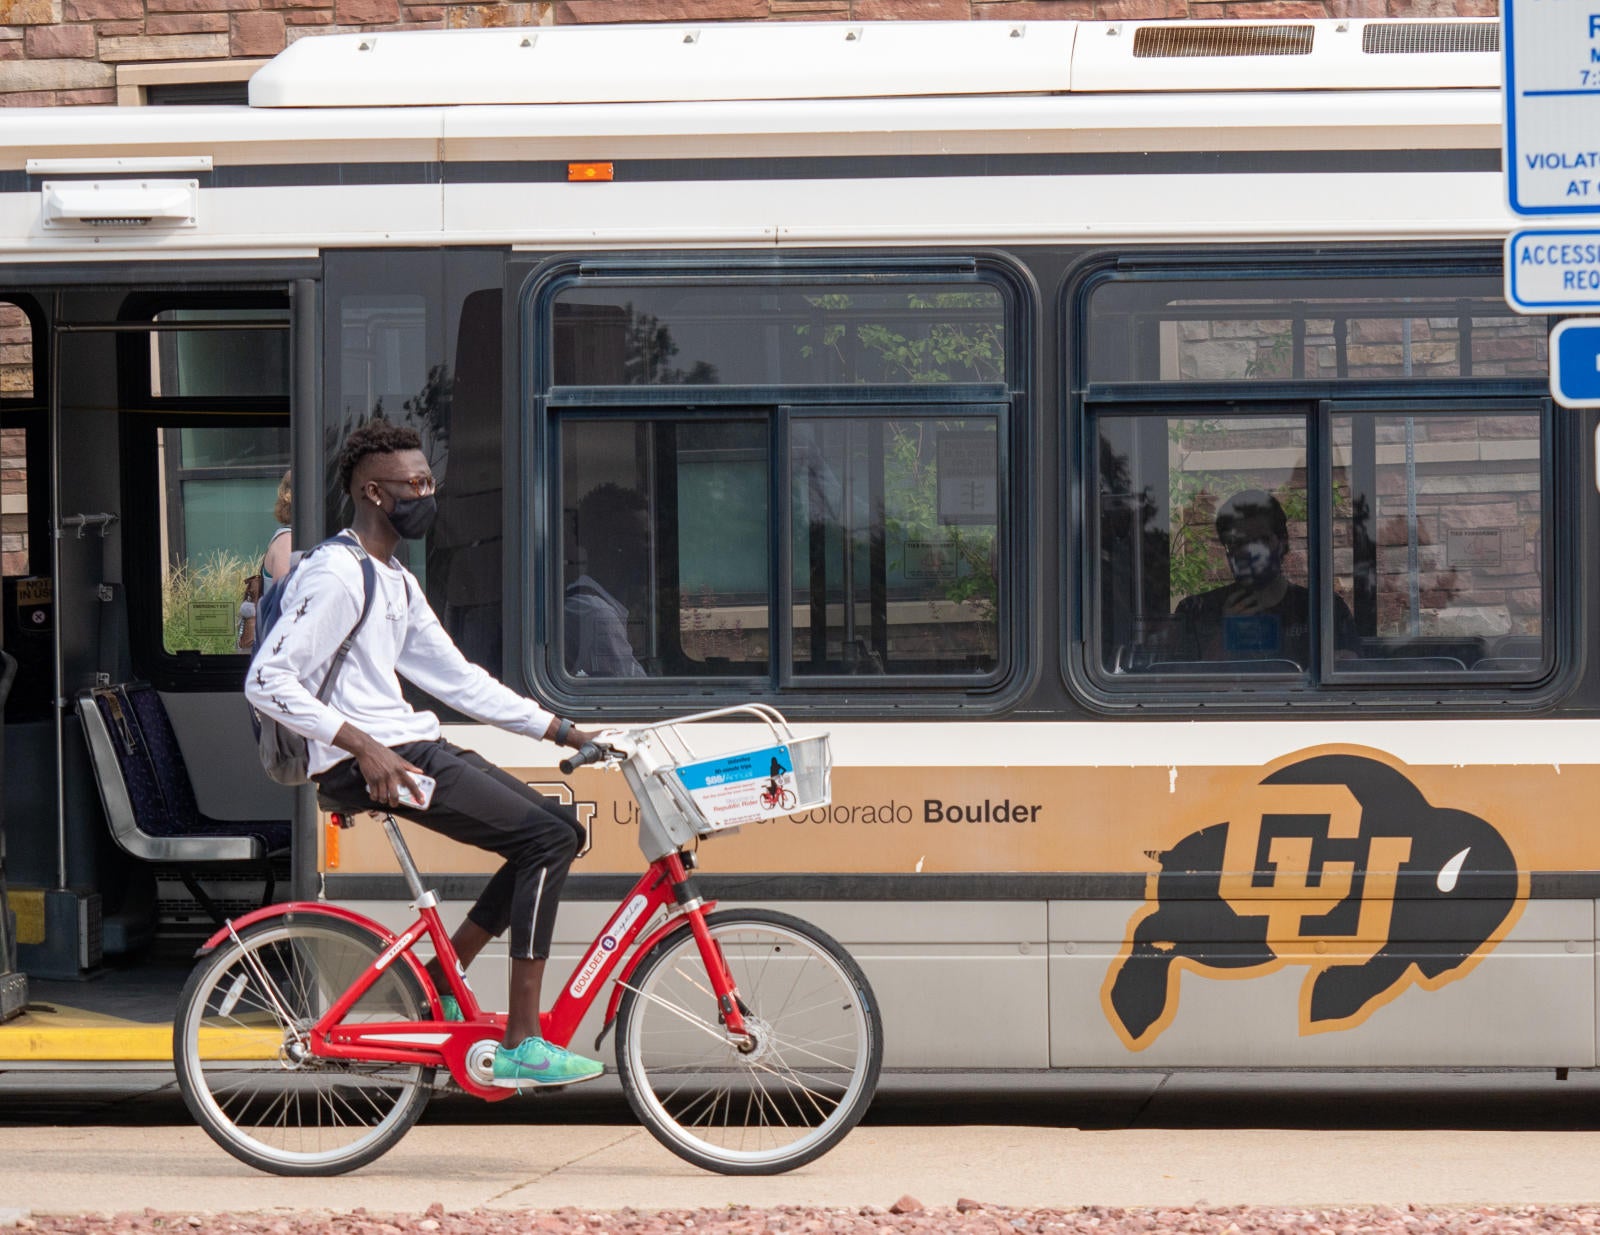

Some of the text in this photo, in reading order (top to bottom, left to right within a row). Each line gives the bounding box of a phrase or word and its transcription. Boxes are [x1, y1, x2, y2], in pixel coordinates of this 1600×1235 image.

[1580, 70, 1600, 86] 7:
[1525, 152, 1600, 169] VIOLAT
[1566, 180, 1591, 196] AT
[924, 799, 1042, 824] Boulder
[574, 950, 605, 993] BOULDER
